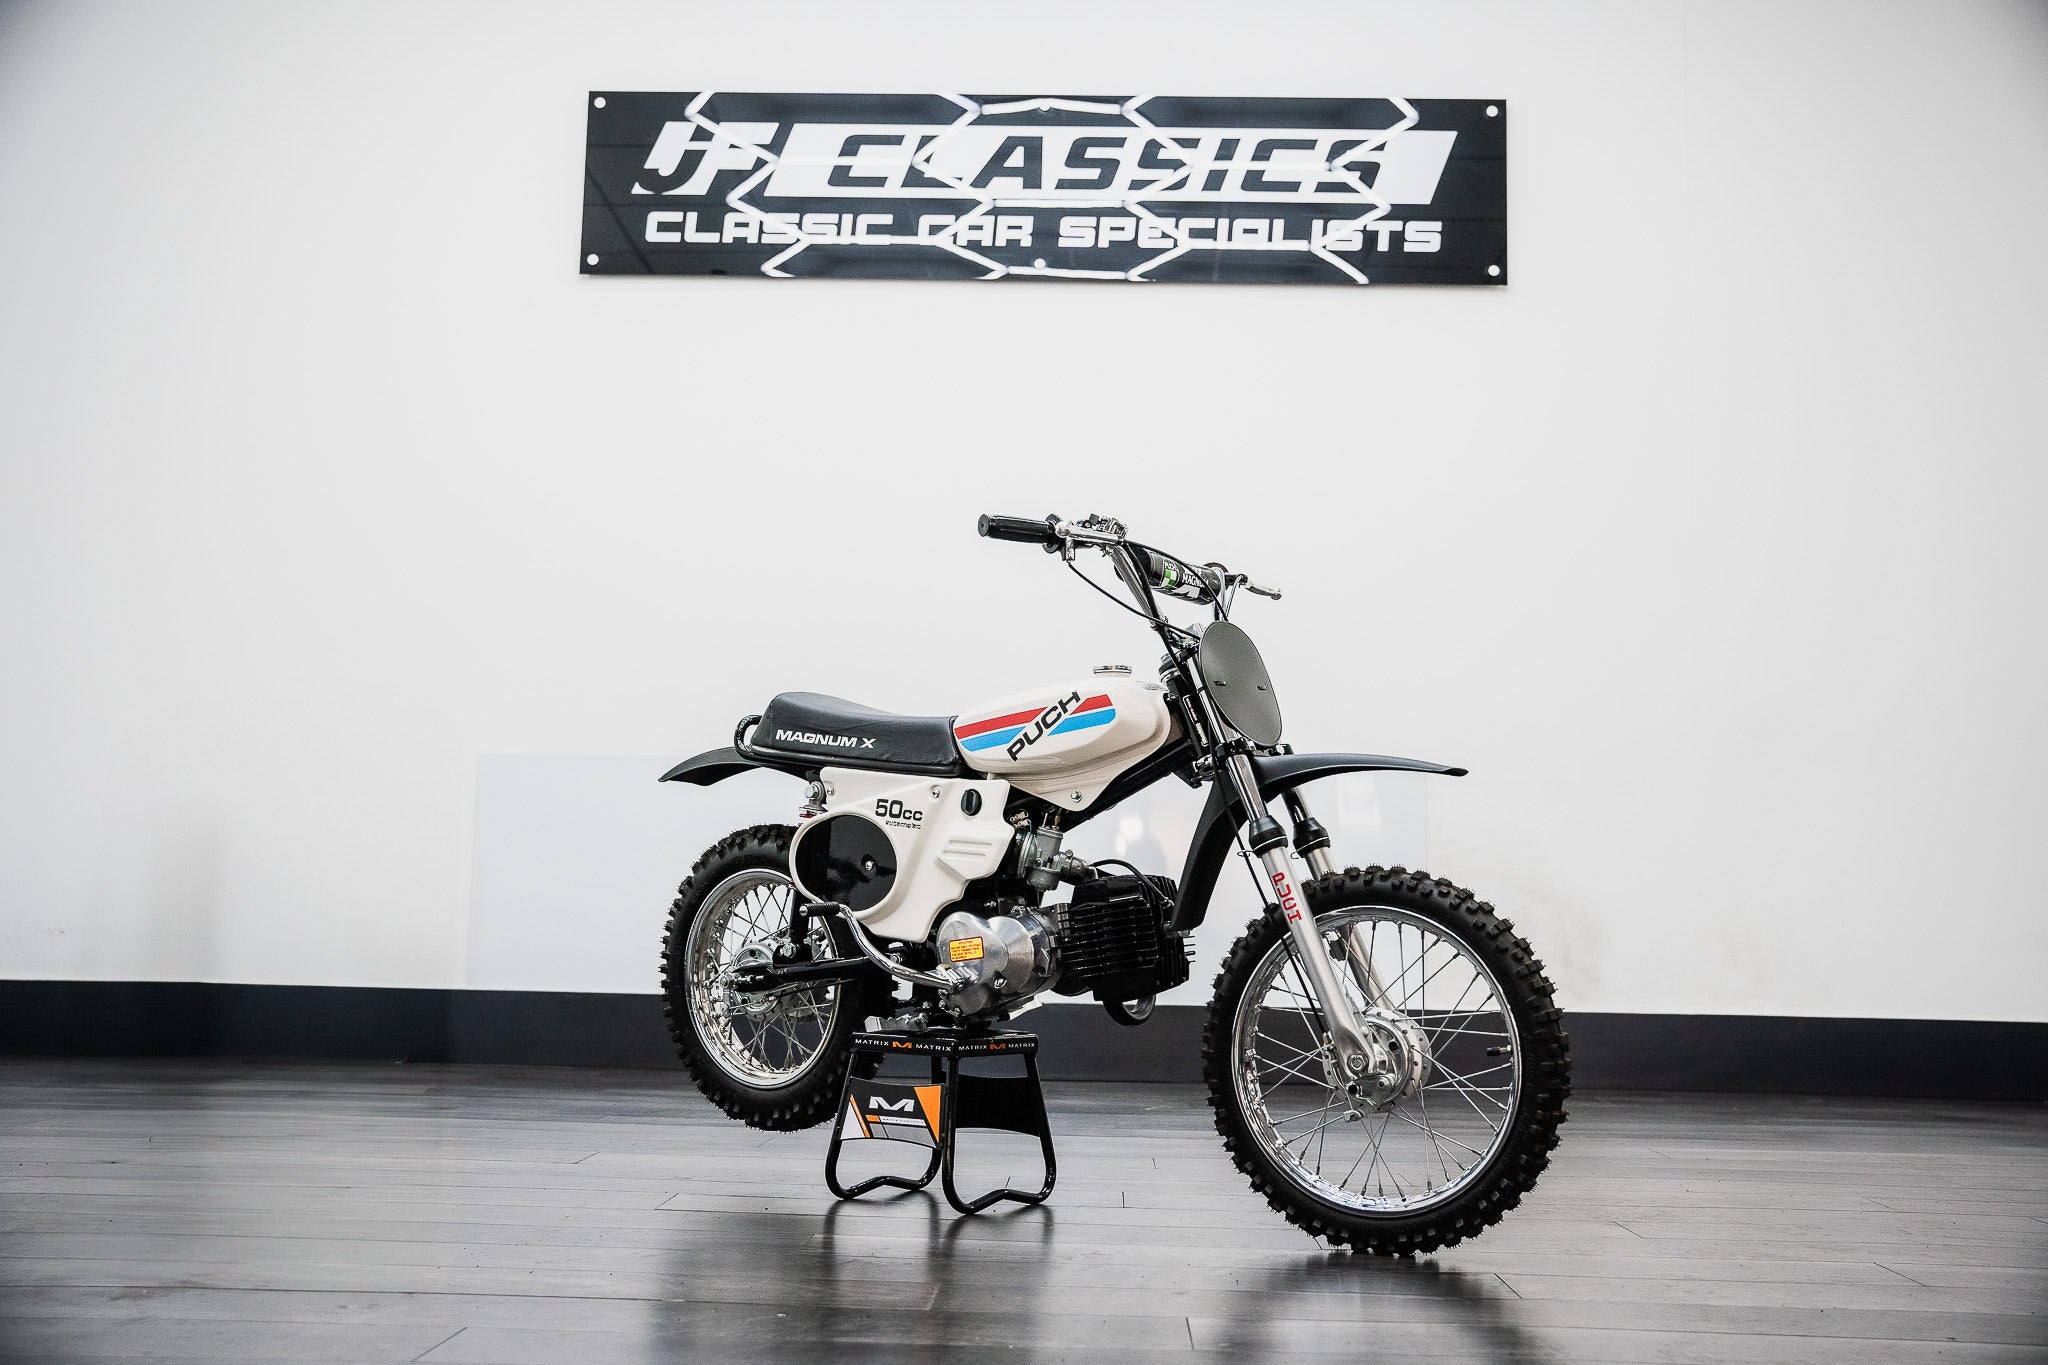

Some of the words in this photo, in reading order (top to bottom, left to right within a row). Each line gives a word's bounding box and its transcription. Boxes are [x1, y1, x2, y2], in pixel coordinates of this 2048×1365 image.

[644, 211, 894, 246] CLASSIC
[917, 214, 1035, 248] CAR
[1057, 216, 1443, 253] SPECIALISTS
[775, 729, 858, 748] MAGNUM
[859, 737, 877, 749] X
[1006, 690, 1081, 762] PUCH
[875, 798, 923, 821] 50cc
[1272, 871, 1303, 925] PUCH
[855, 1038, 889, 1047] MATRIX
[915, 1043, 952, 1052] MATRIX
